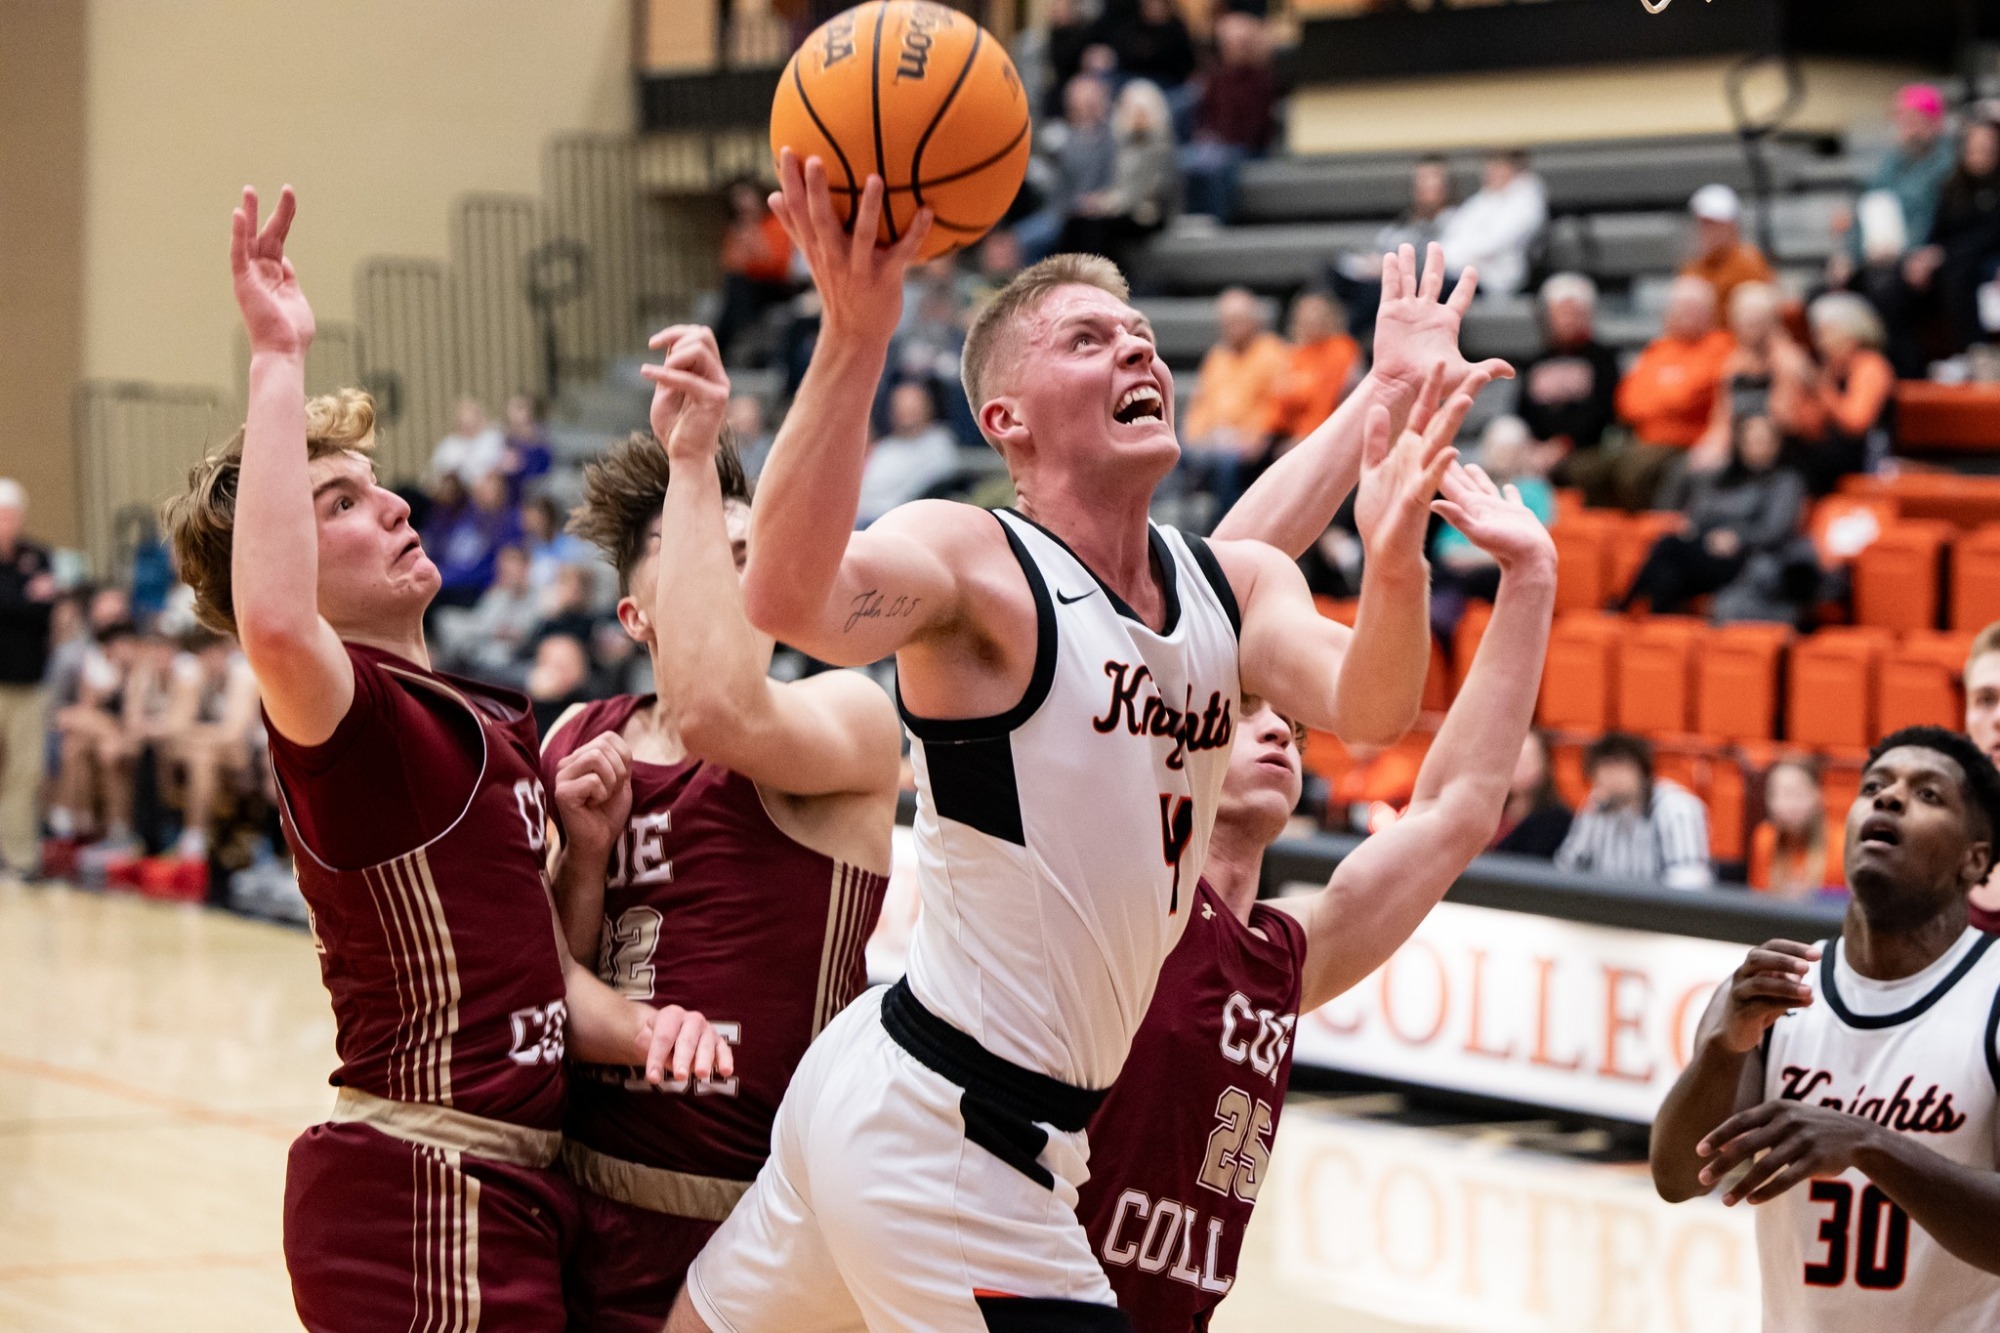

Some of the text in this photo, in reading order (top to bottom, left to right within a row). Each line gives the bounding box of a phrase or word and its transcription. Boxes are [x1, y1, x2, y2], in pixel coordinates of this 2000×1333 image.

[844, 589, 884, 633] John
[1196, 1084, 1273, 1206] 25
[1803, 1178, 1911, 1291] 30
